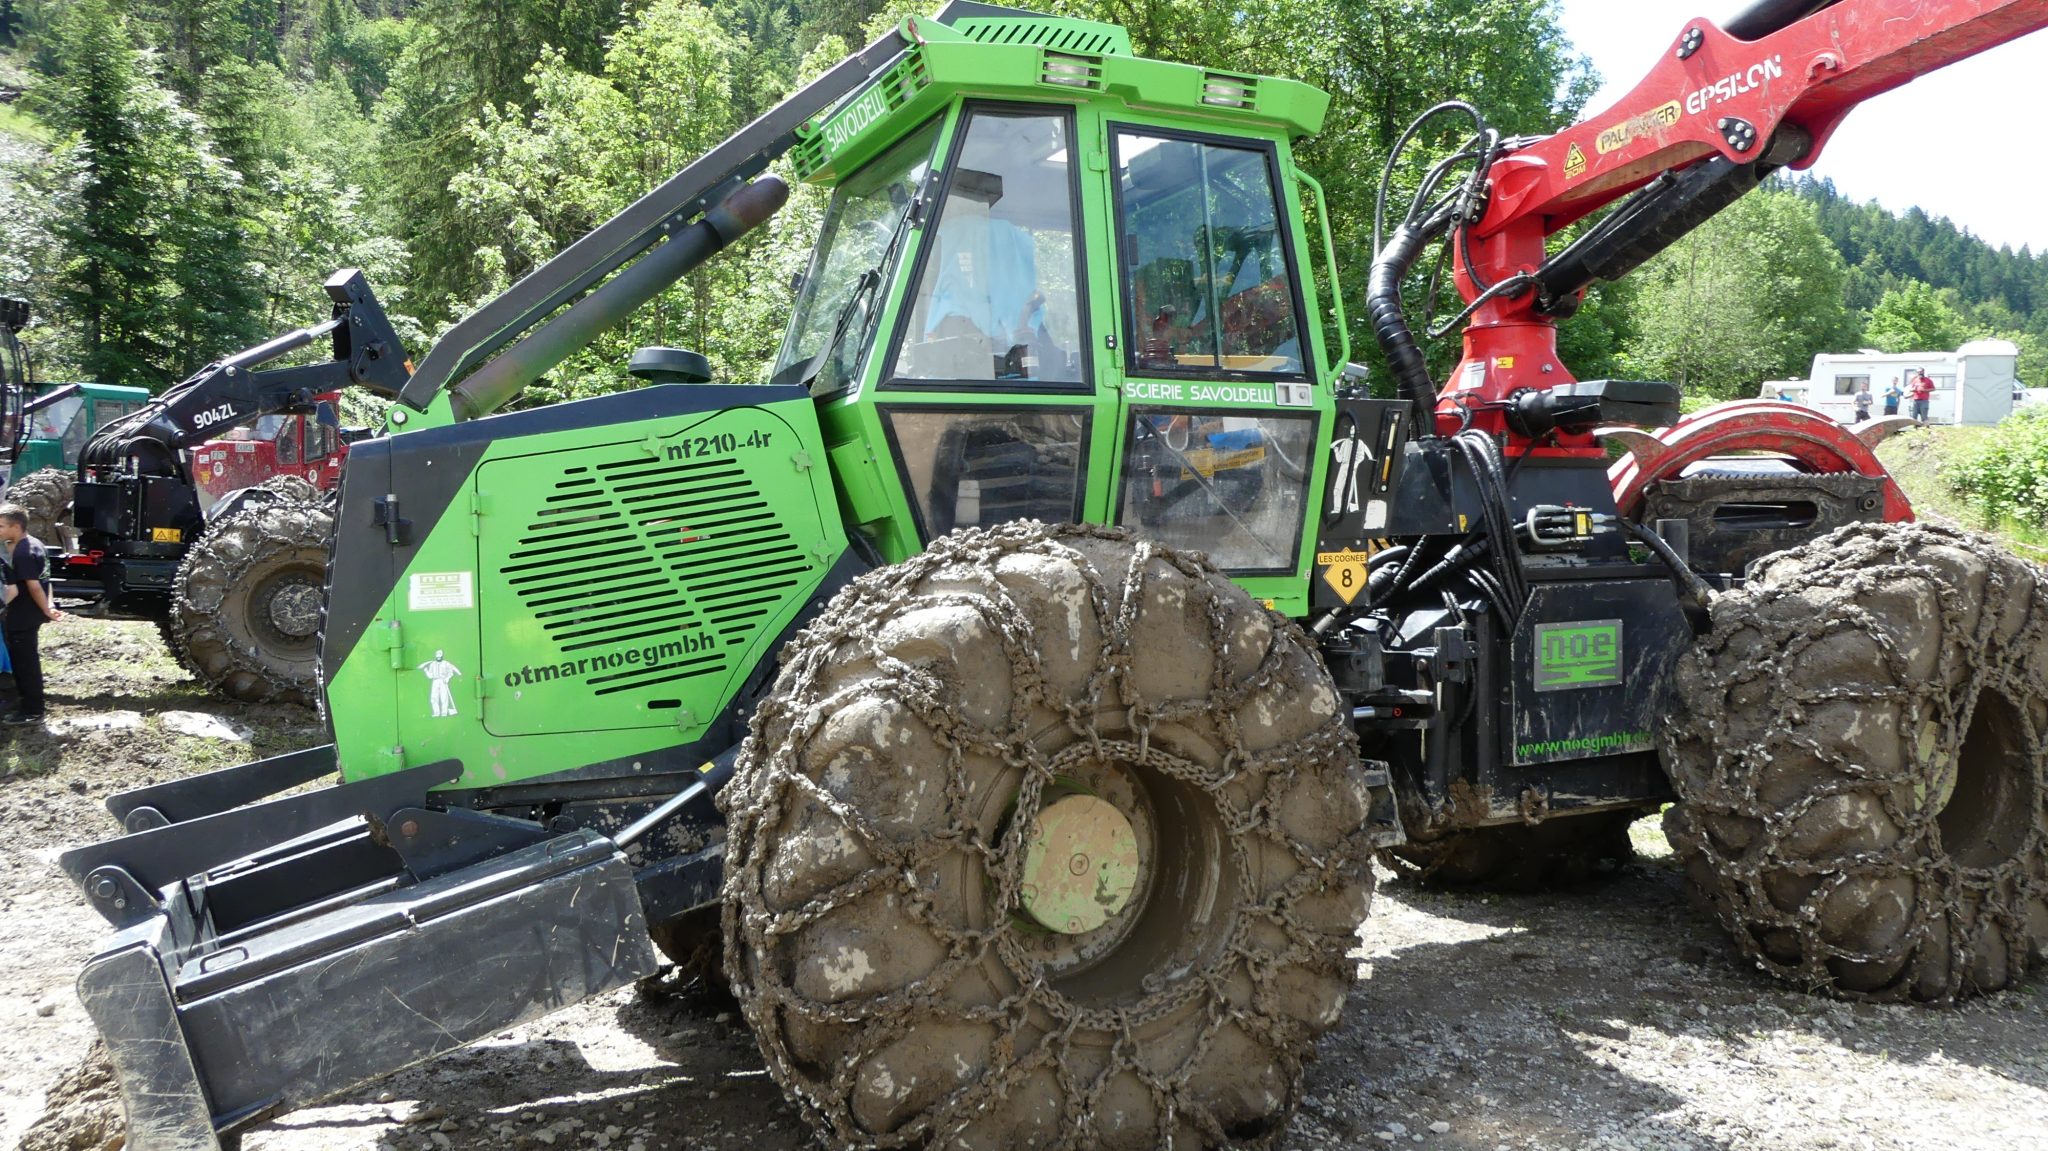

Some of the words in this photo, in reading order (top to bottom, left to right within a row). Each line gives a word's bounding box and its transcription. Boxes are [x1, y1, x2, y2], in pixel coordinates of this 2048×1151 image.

[1686, 55, 1783, 115] EPSILON
[826, 87, 886, 153] SAVOLDELLI
[1126, 383, 1184, 400] SCIERIE
[1190, 385, 1273, 403] SAVOLDELLI
[194, 403, 238, 429] 904ZL
[1319, 555, 1333, 563] LES
[1342, 569, 1352, 588] 8
[1546, 632, 1611, 660] noe
